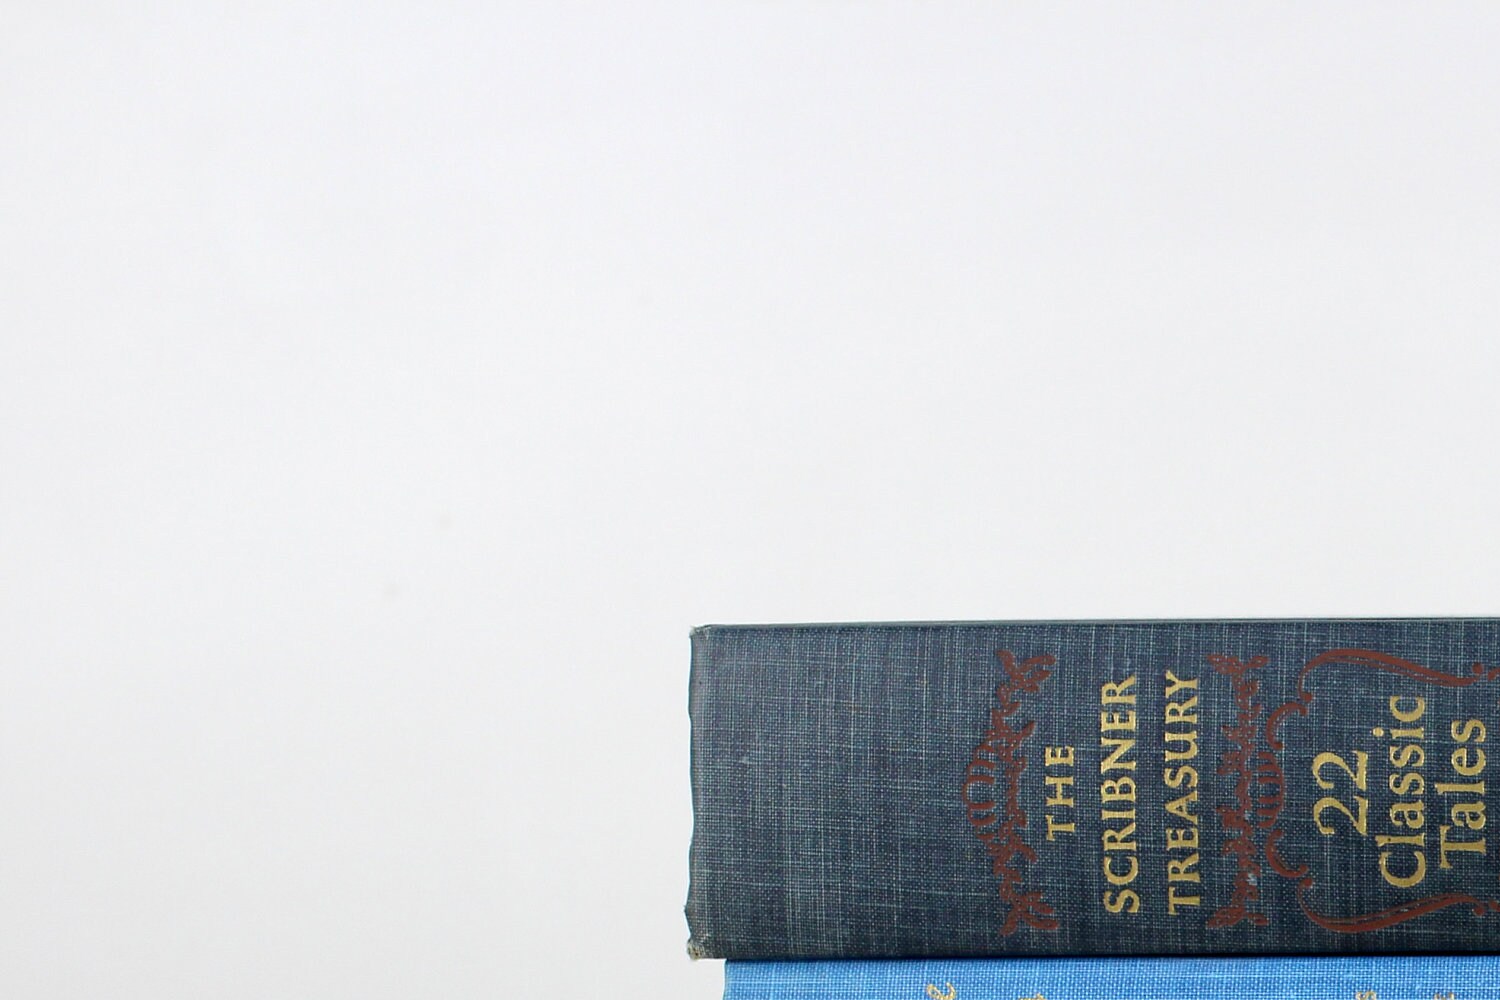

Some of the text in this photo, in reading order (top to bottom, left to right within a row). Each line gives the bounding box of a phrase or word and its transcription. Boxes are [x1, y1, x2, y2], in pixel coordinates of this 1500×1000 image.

[1045, 745, 1075, 841] THE
[1100, 673, 1140, 914] SCRIBNER
[1165, 671, 1200, 915] TREASURY
[1312, 750, 1369, 837] 22
[1372, 695, 1426, 888] Classic
[1435, 718, 1487, 870] Tales
